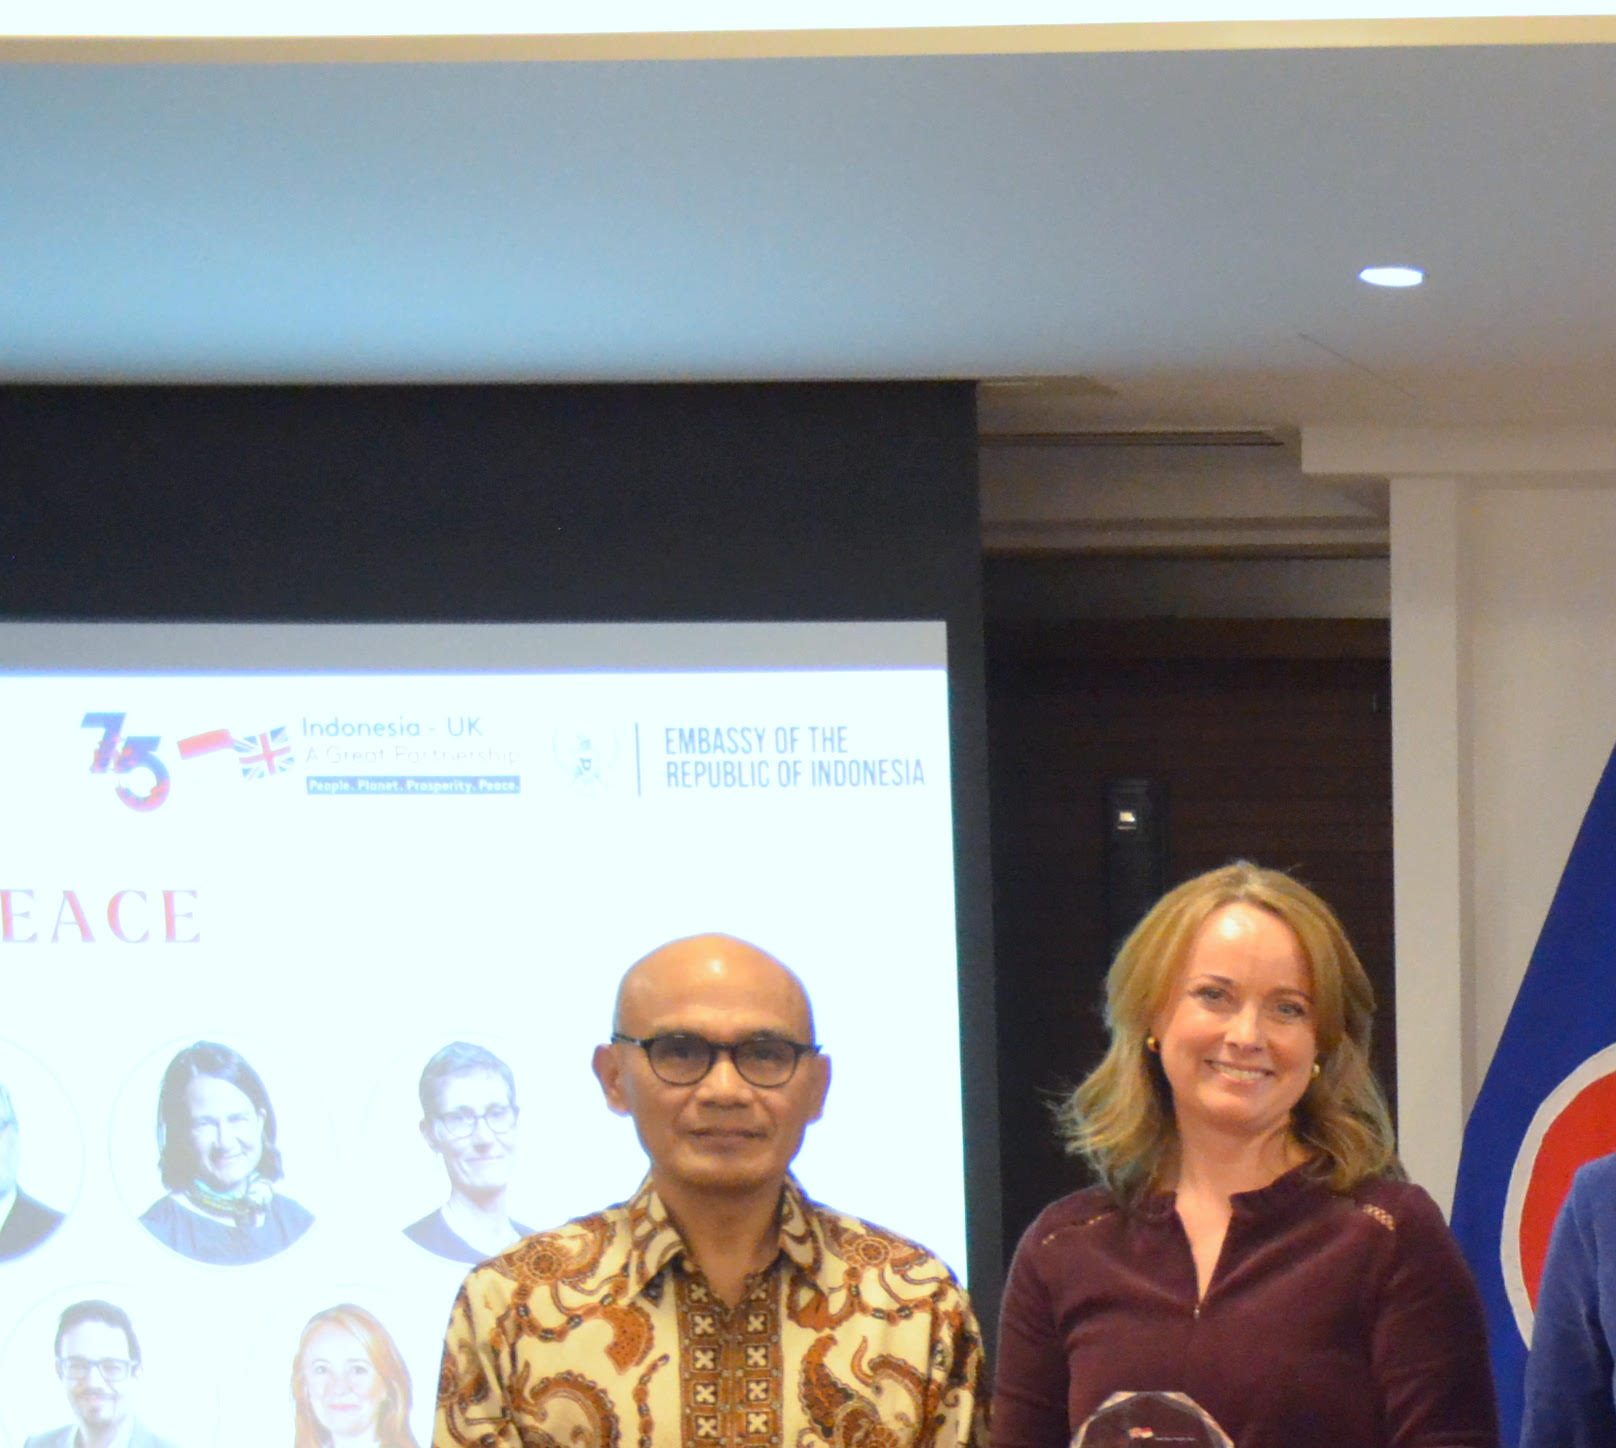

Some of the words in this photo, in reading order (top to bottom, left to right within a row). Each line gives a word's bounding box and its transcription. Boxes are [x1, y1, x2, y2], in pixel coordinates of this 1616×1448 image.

[302, 716, 421, 737] Indonesia
[446, 716, 484, 737] UK
[664, 726, 766, 755] EMBASSY
[774, 726, 801, 754] OF
[807, 725, 849, 754] THE
[80, 711, 171, 812] 75
[394, 745, 521, 767] Partnership
[665, 760, 771, 788] REPUBLIC
[777, 759, 803, 788] OF
[811, 758, 926, 787] INDONESIA
[0, 889, 201, 943] EACE
